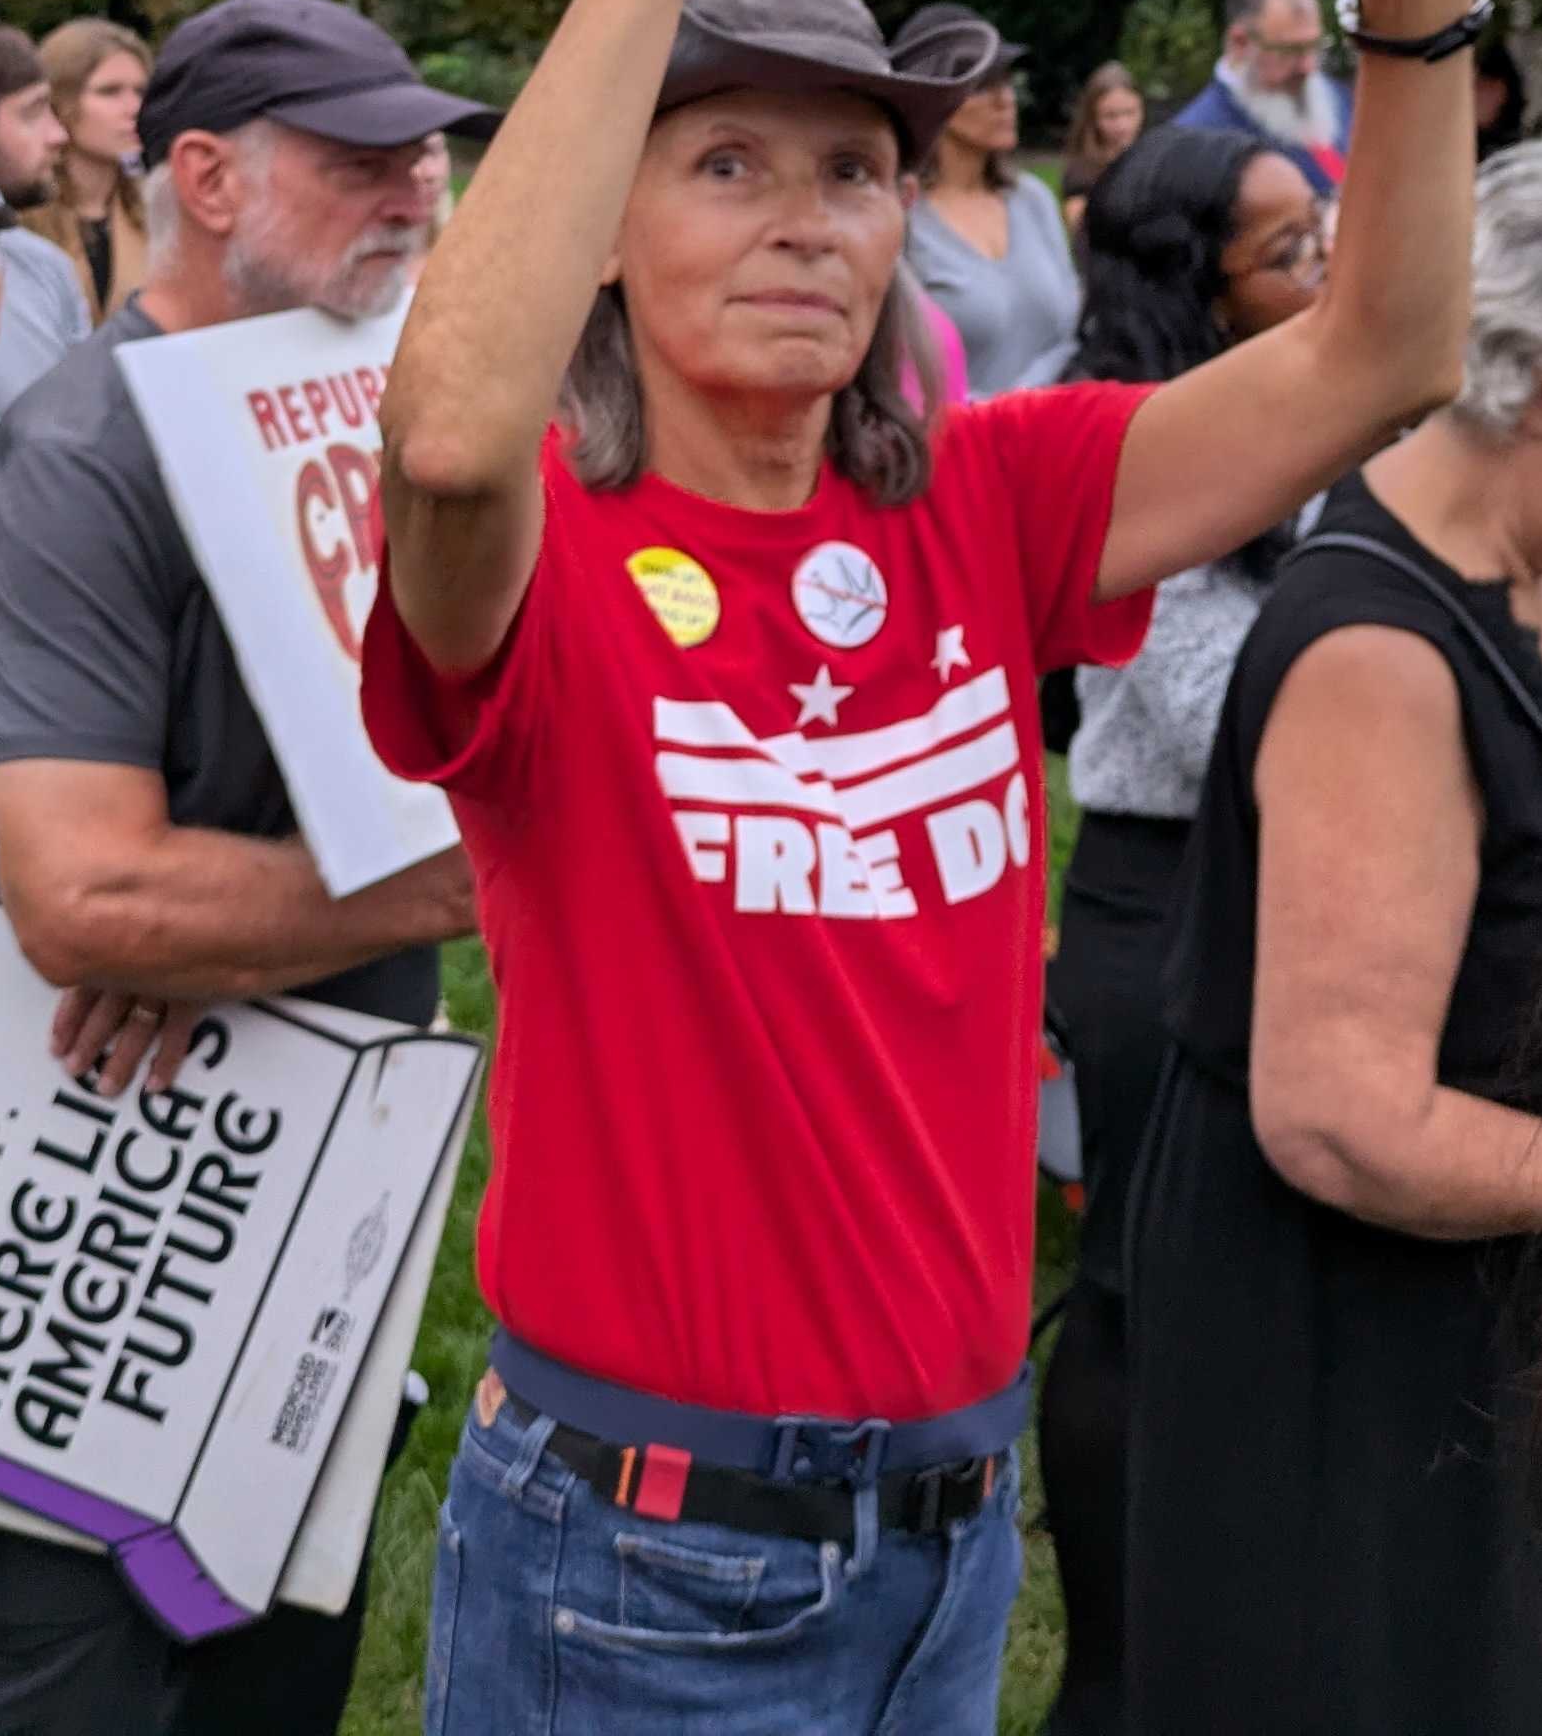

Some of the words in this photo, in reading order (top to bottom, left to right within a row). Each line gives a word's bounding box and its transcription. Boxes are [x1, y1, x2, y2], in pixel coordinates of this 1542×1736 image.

[246, 364, 390, 452] REPUB
[671, 809, 919, 921] FREE
[101, 1089, 283, 1426] FUTURE
